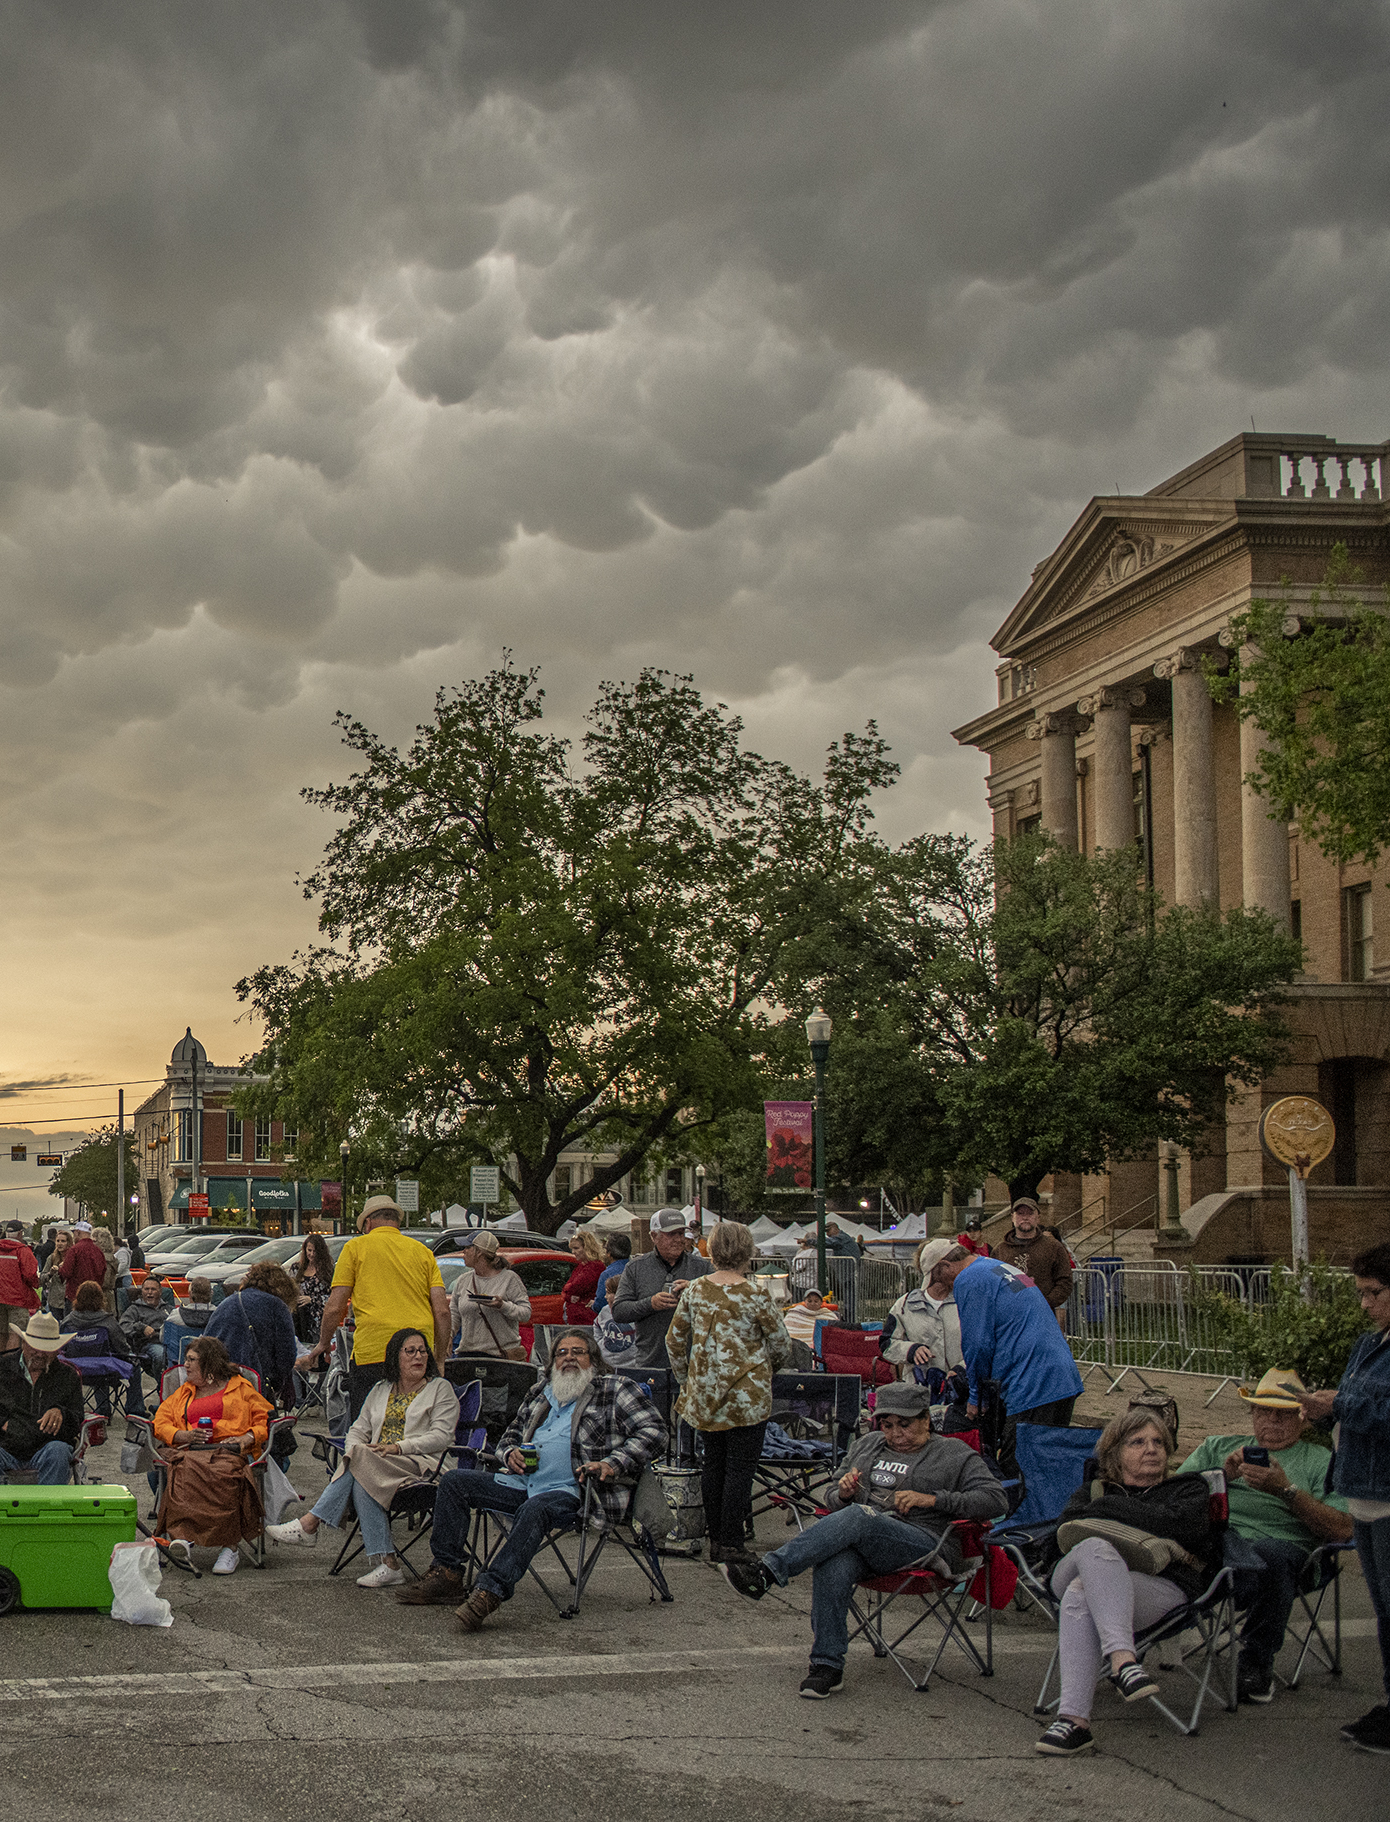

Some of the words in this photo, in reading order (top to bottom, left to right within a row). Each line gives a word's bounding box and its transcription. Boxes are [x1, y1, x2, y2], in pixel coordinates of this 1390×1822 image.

[766, 1110, 782, 1119] Red
[784, 1110, 808, 1120] Poppy
[773, 1117, 803, 1126] Festival
[603, 1329, 632, 1343] NASA
[873, 1460, 910, 1475] ANTO
